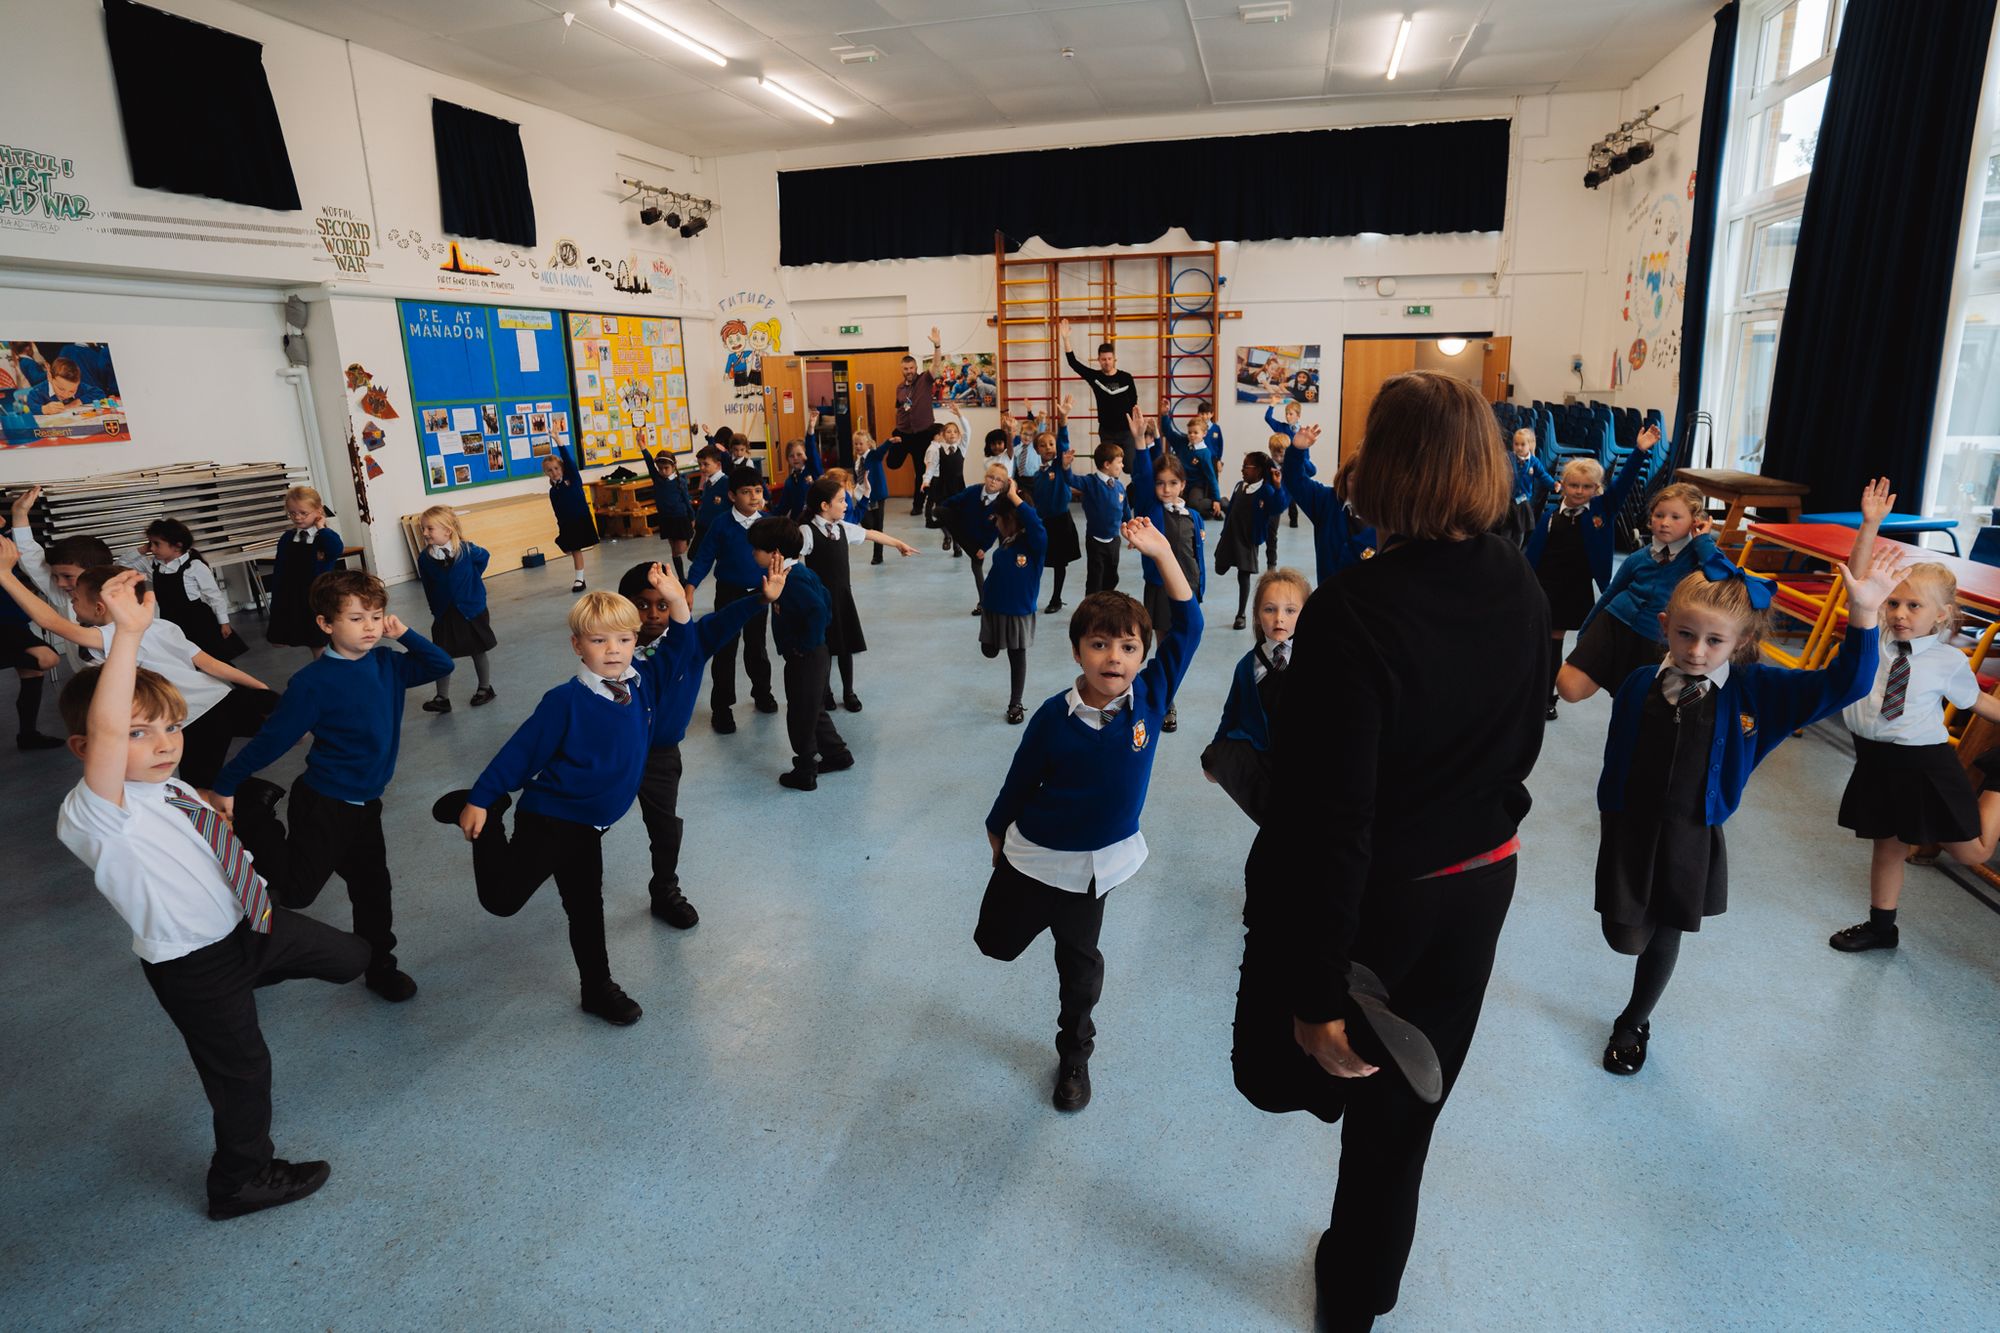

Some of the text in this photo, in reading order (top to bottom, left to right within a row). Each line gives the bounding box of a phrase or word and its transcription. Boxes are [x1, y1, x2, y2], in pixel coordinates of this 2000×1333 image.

[0, 165, 56, 194] IRST
[40, 192, 95, 221] WAR
[315, 217, 370, 240] SECOND
[320, 236, 370, 257] WORLD
[332, 254, 367, 273] WAR
[652, 260, 673, 276] NEW
[718, 291, 775, 312] FUTURE
[455, 310, 471, 324] AT
[409, 323, 484, 340] MANADON
